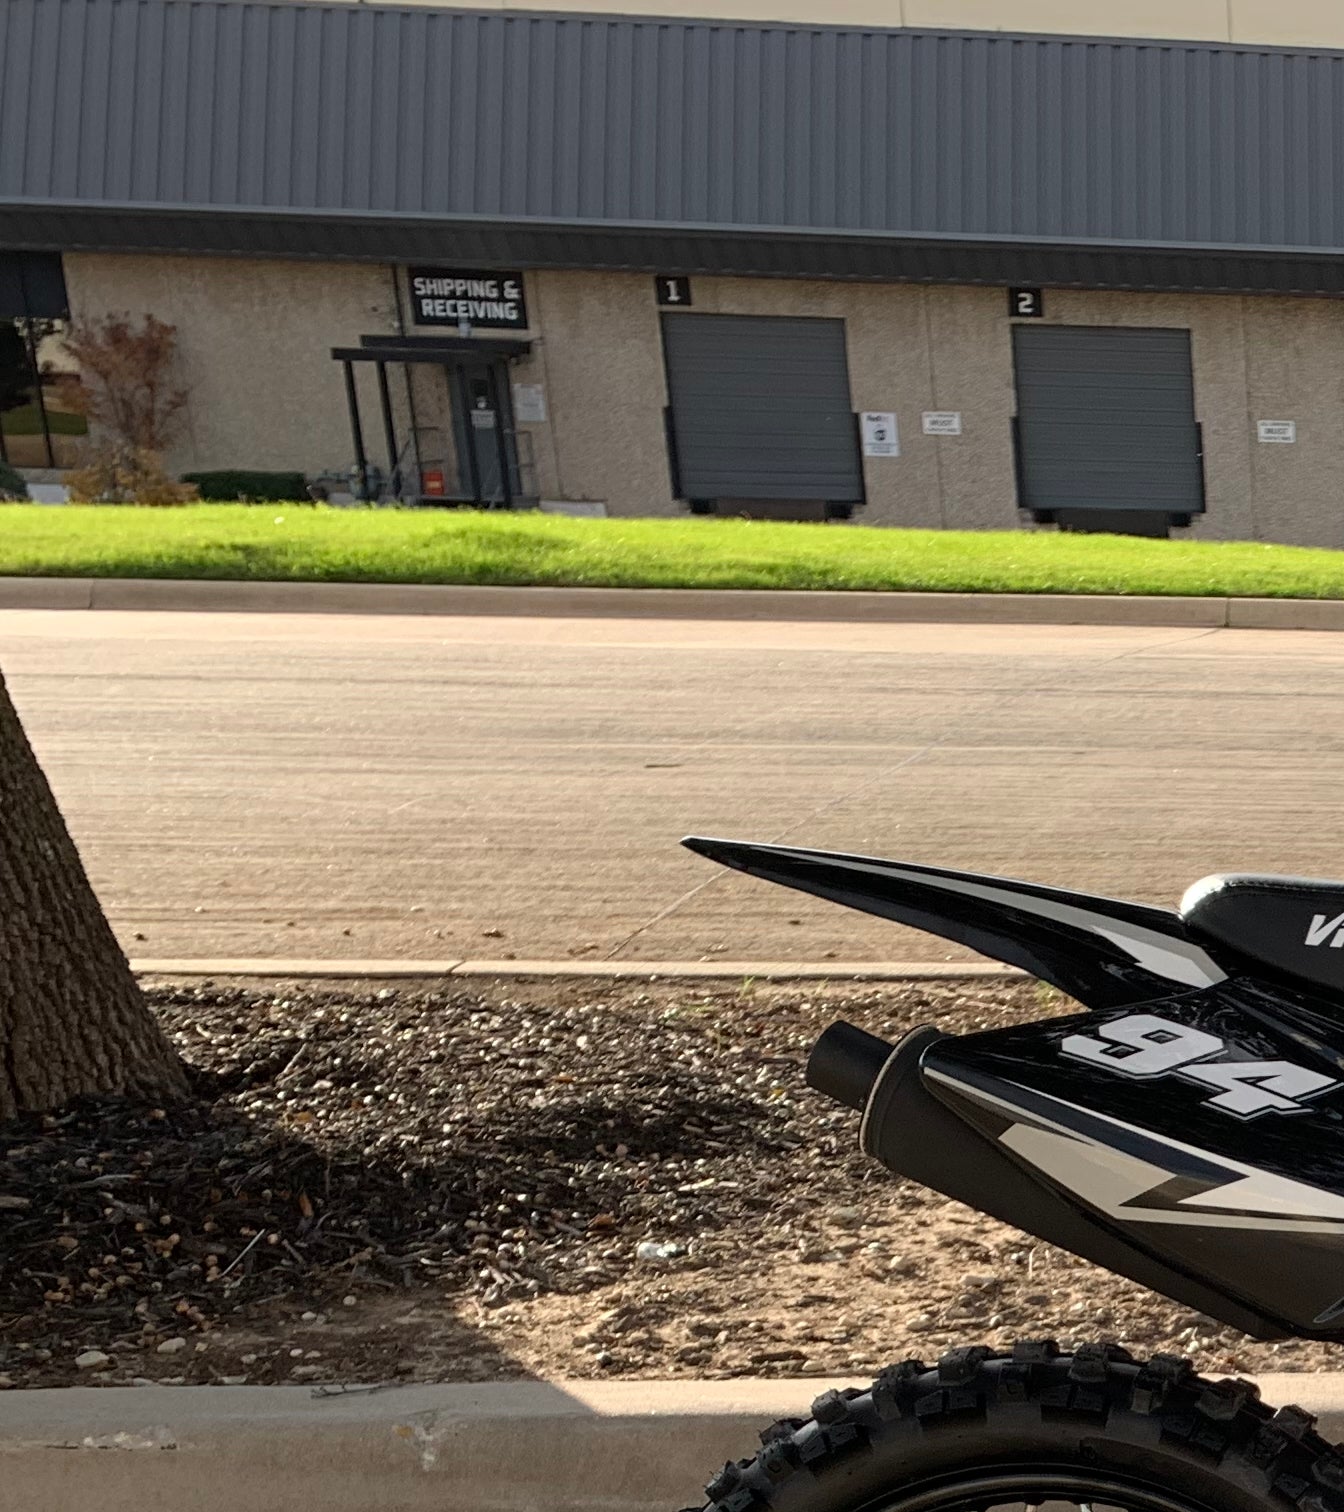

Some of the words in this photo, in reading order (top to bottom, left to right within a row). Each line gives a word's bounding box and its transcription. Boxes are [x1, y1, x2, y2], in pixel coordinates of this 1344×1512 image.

[414, 277, 498, 298] SHIPPING
[503, 280, 520, 299] &
[667, 281, 680, 301] 1
[421, 299, 518, 320] RECEIVING
[1018, 293, 1033, 313] 2
